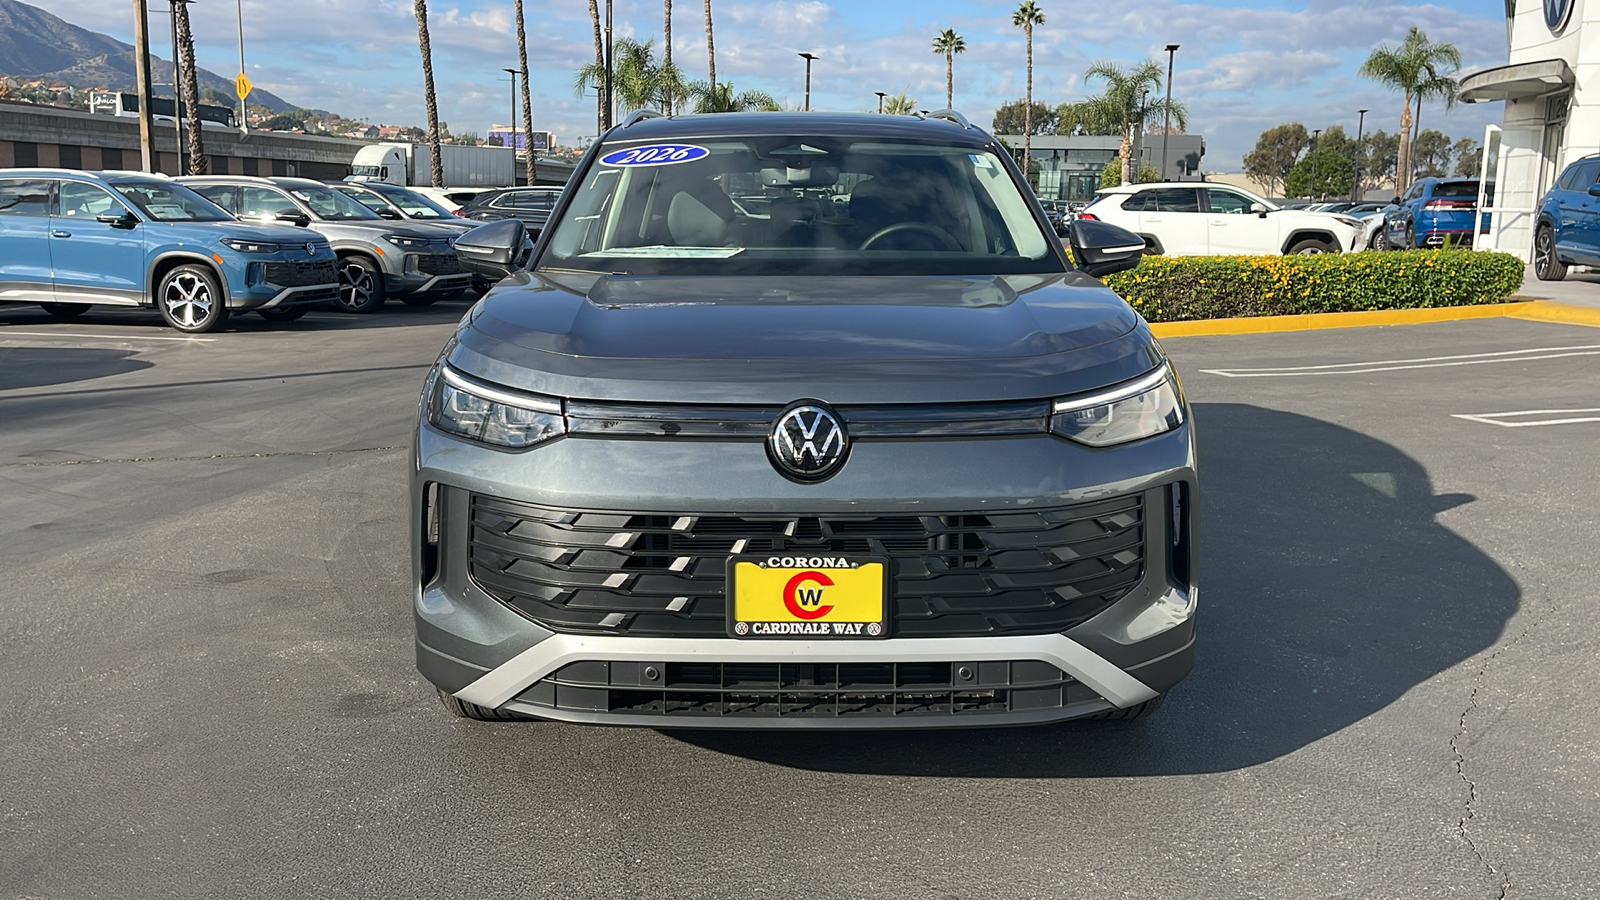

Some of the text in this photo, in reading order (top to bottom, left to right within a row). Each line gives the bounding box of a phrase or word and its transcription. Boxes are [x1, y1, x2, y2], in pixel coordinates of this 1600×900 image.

[616, 147, 696, 164] 2026
[767, 557, 850, 568] CORONA
[752, 623, 864, 635] CARDINALE WAY
